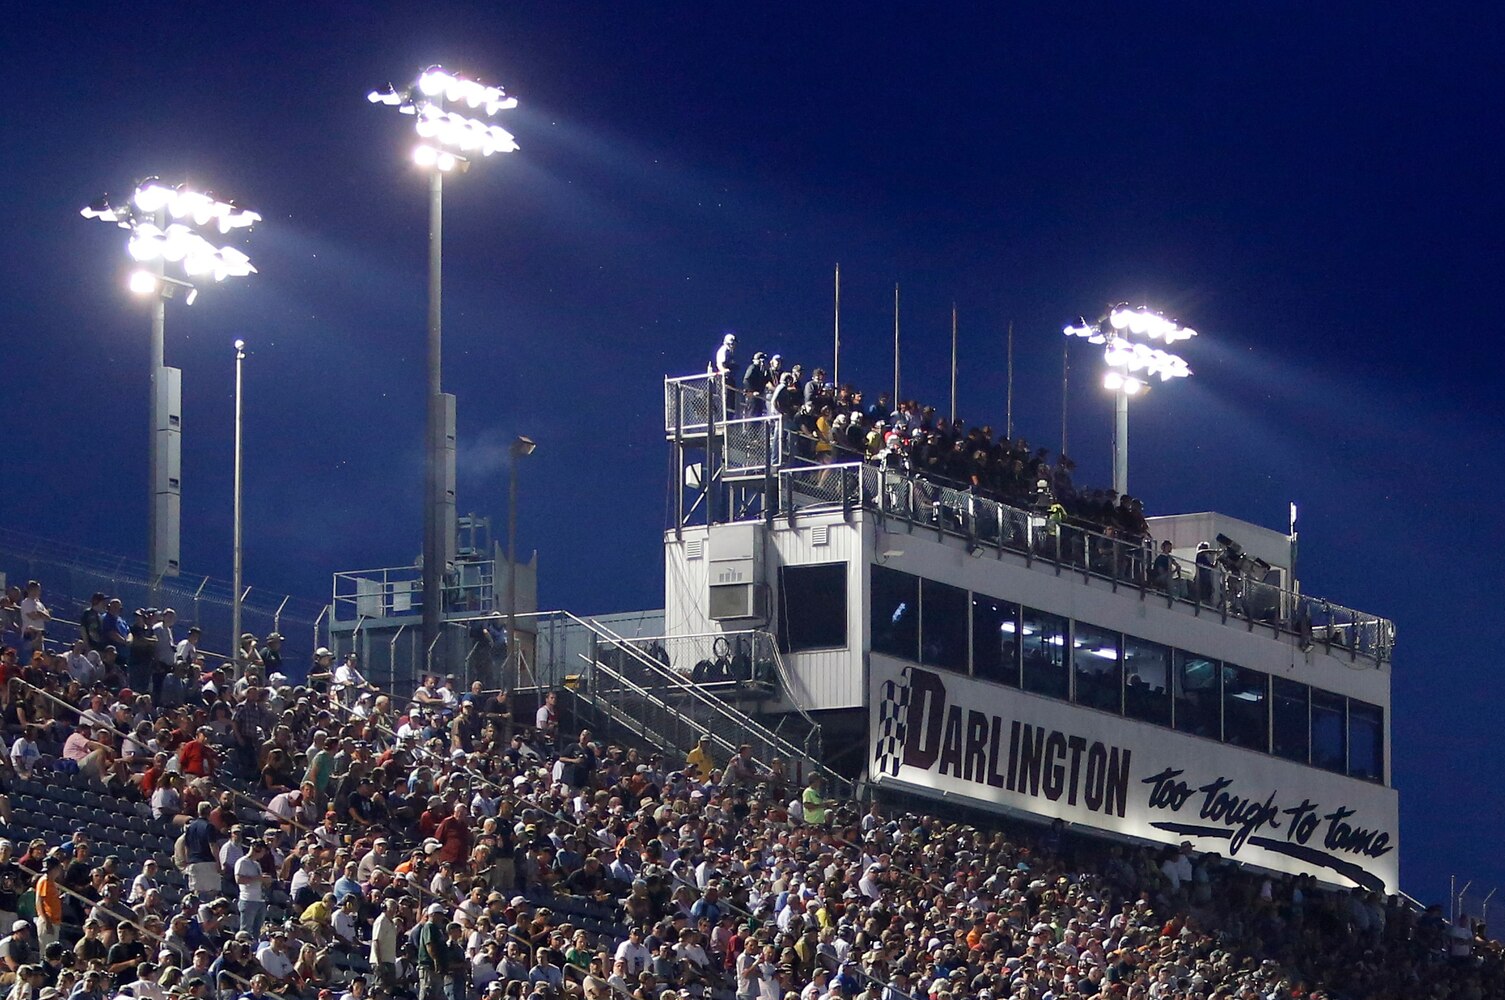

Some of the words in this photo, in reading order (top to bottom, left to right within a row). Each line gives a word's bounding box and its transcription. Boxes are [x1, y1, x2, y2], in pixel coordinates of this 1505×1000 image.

[903, 667, 1132, 818] DARLINGTON
[1141, 767, 1197, 811] too
[1199, 776, 1281, 856] tough
[1283, 799, 1321, 844] to
[1324, 806, 1393, 858] tame
